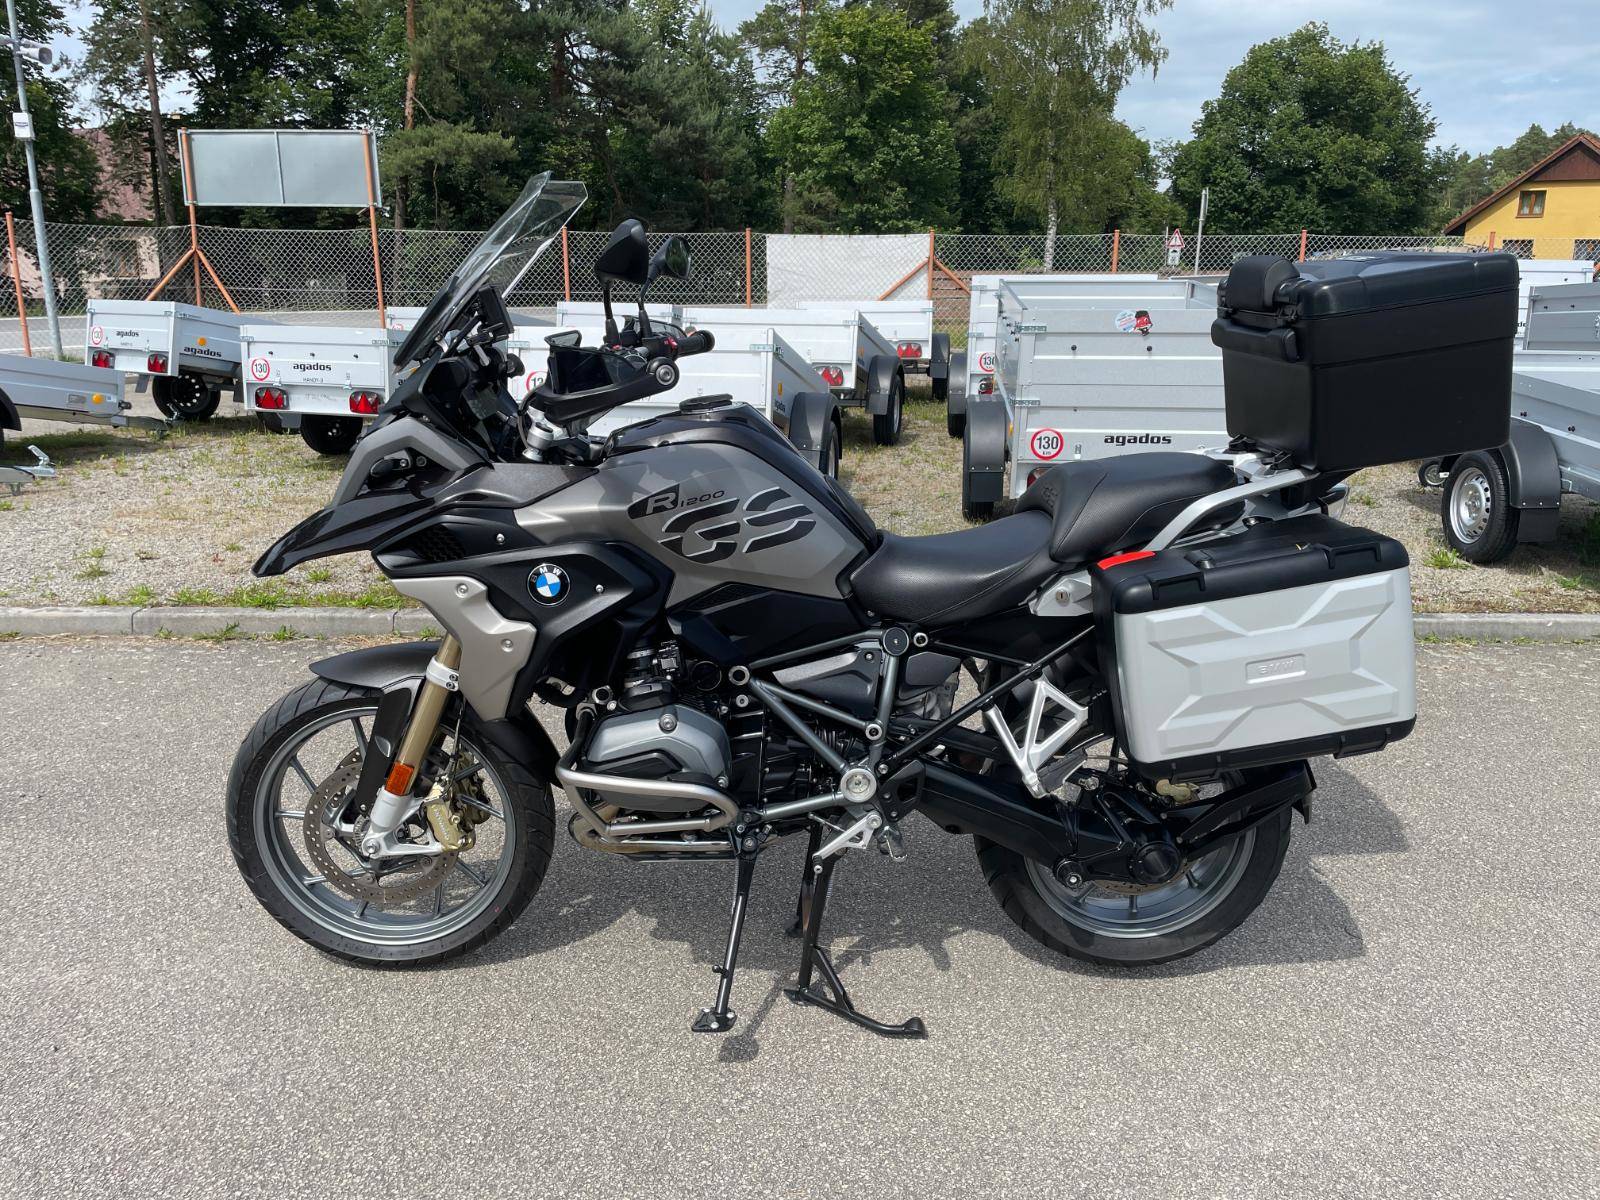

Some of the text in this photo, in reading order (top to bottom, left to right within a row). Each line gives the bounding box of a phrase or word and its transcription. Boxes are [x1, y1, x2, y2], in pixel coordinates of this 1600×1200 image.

[116, 330, 139, 338] agados
[183, 345, 222, 358] agados
[254, 363, 267, 373] 130
[293, 362, 331, 371] agados
[1037, 436, 1059, 450] 130
[1104, 433, 1172, 446] agados
[646, 490, 725, 515] R 1200
[658, 486, 816, 564] GS
[531, 566, 562, 583] BMW
